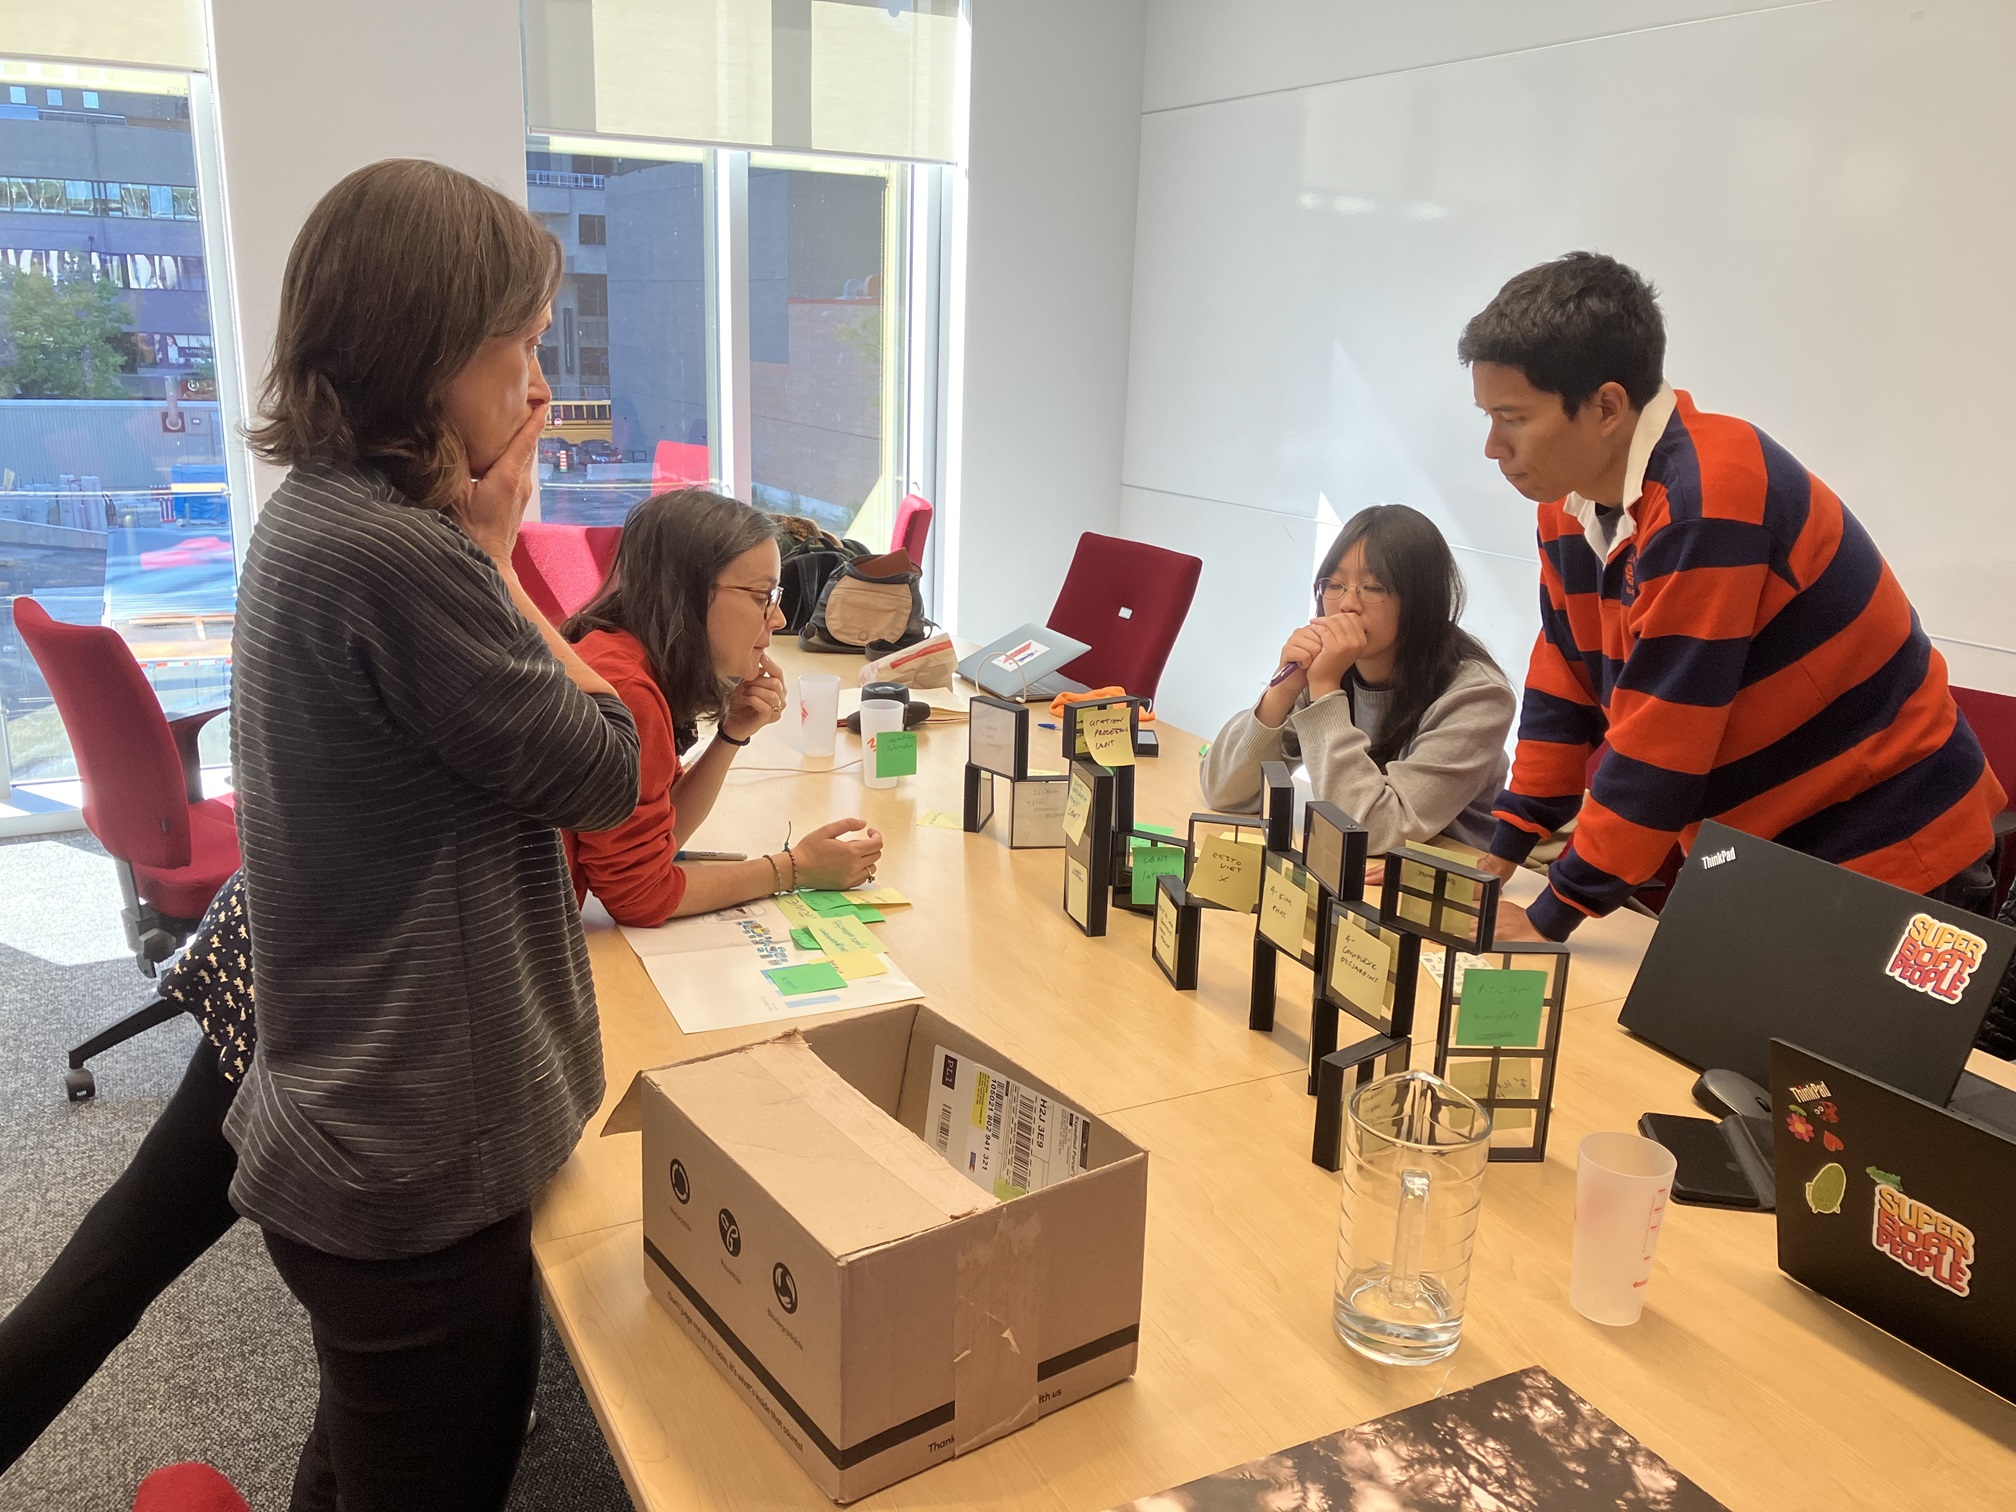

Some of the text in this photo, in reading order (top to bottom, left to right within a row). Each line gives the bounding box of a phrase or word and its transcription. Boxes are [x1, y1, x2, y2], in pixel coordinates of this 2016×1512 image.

[1702, 846, 1736, 870] ThinkPad
[1899, 935, 1976, 974] BOAT
[1908, 916, 1984, 962] SUPER
[1889, 953, 1967, 1001] PEOPLE
[988, 1079, 997, 1112] 105021
[1790, 1080, 1832, 1104] ThinkPad
[1036, 1098, 1048, 1149] H2J 3E9
[1878, 1207, 1969, 1265] BOAT
[1879, 1187, 1971, 1250] SUPER
[1877, 1225, 1967, 1293] PEOPLE
[928, 1388, 1062, 1453] Thank ith us
